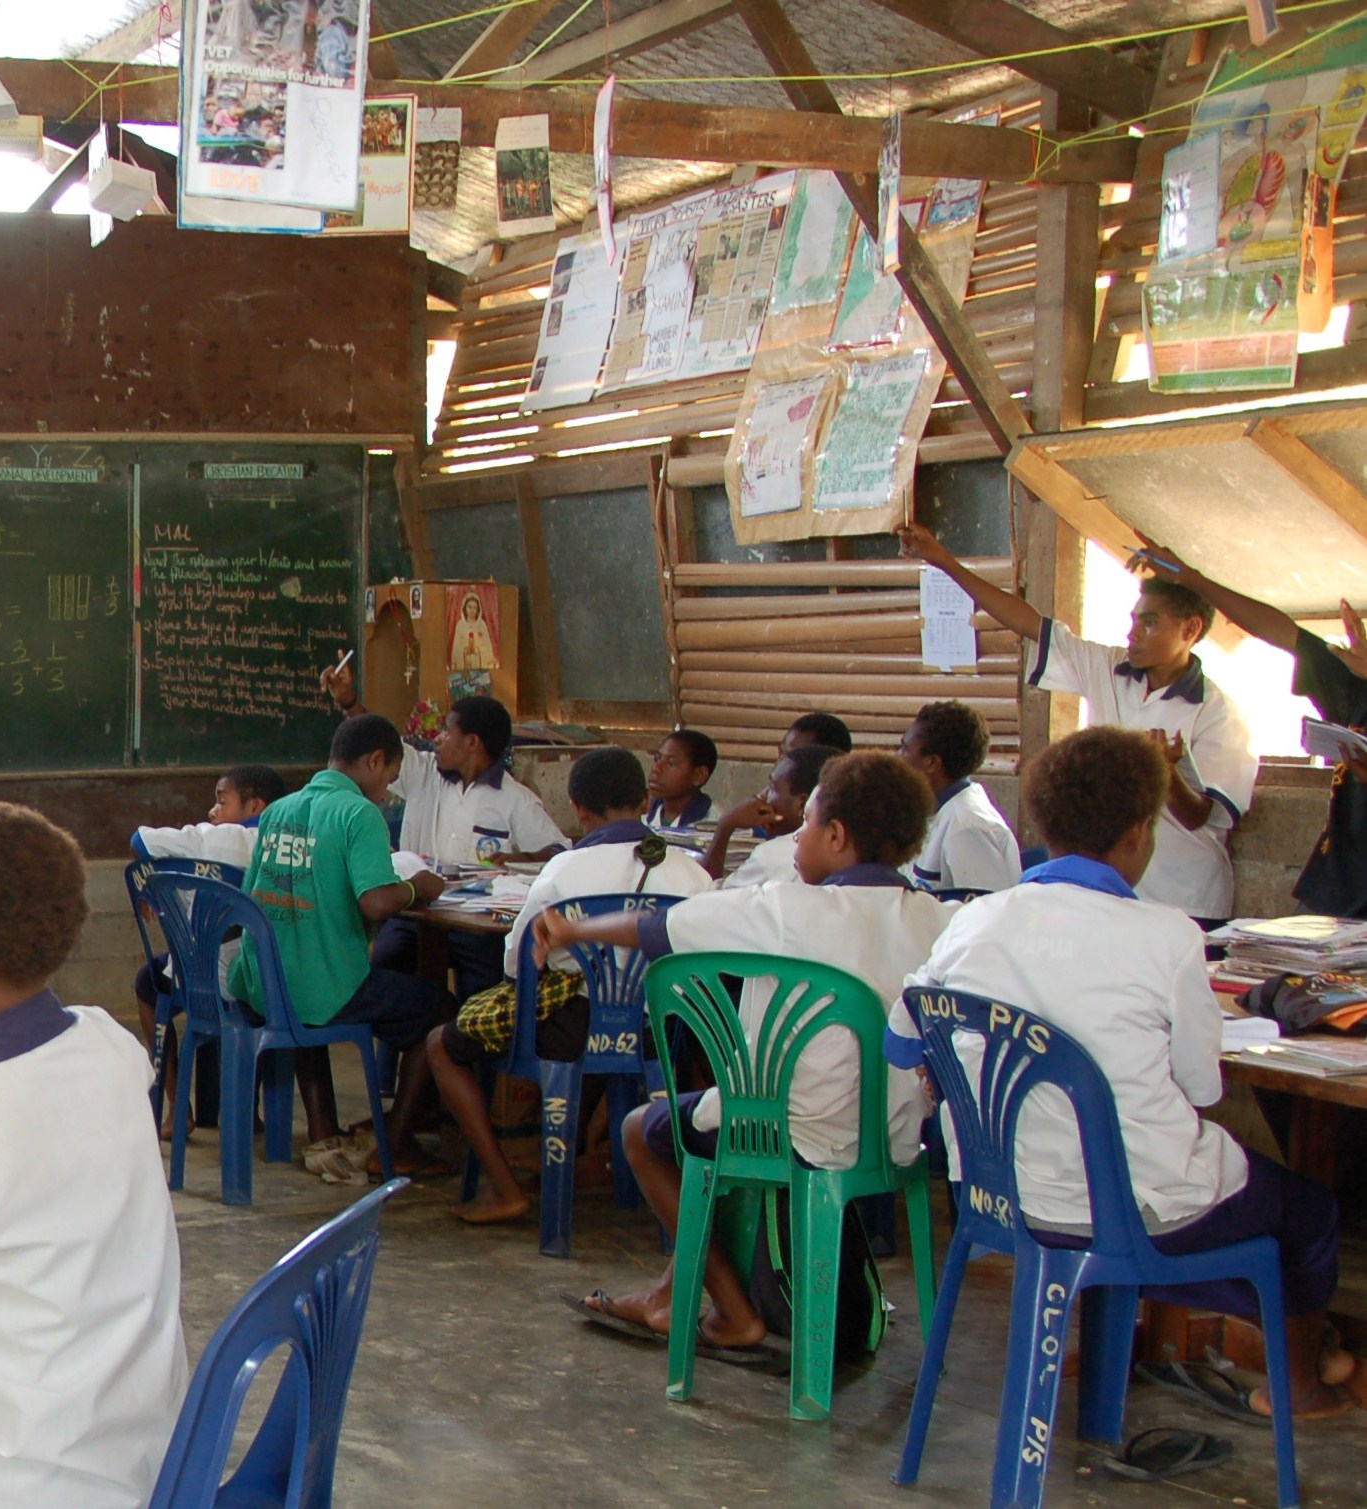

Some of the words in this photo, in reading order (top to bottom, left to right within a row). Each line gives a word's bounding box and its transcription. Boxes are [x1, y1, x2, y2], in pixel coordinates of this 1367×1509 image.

[205, 60, 287, 83] Opportunities
[288, 71, 305, 83] for
[305, 73, 345, 88] further
[209, 169, 261, 194] LOVE
[30, 444, 52, 467] Yy
[31, 469, 96, 482] DEVELOPMENT
[205, 464, 253, 478] CHRISTIAN
[920, 994, 967, 1022] OLOL
[546, 1136, 566, 1167] 62
[1021, 1416, 1049, 1467] P/S
